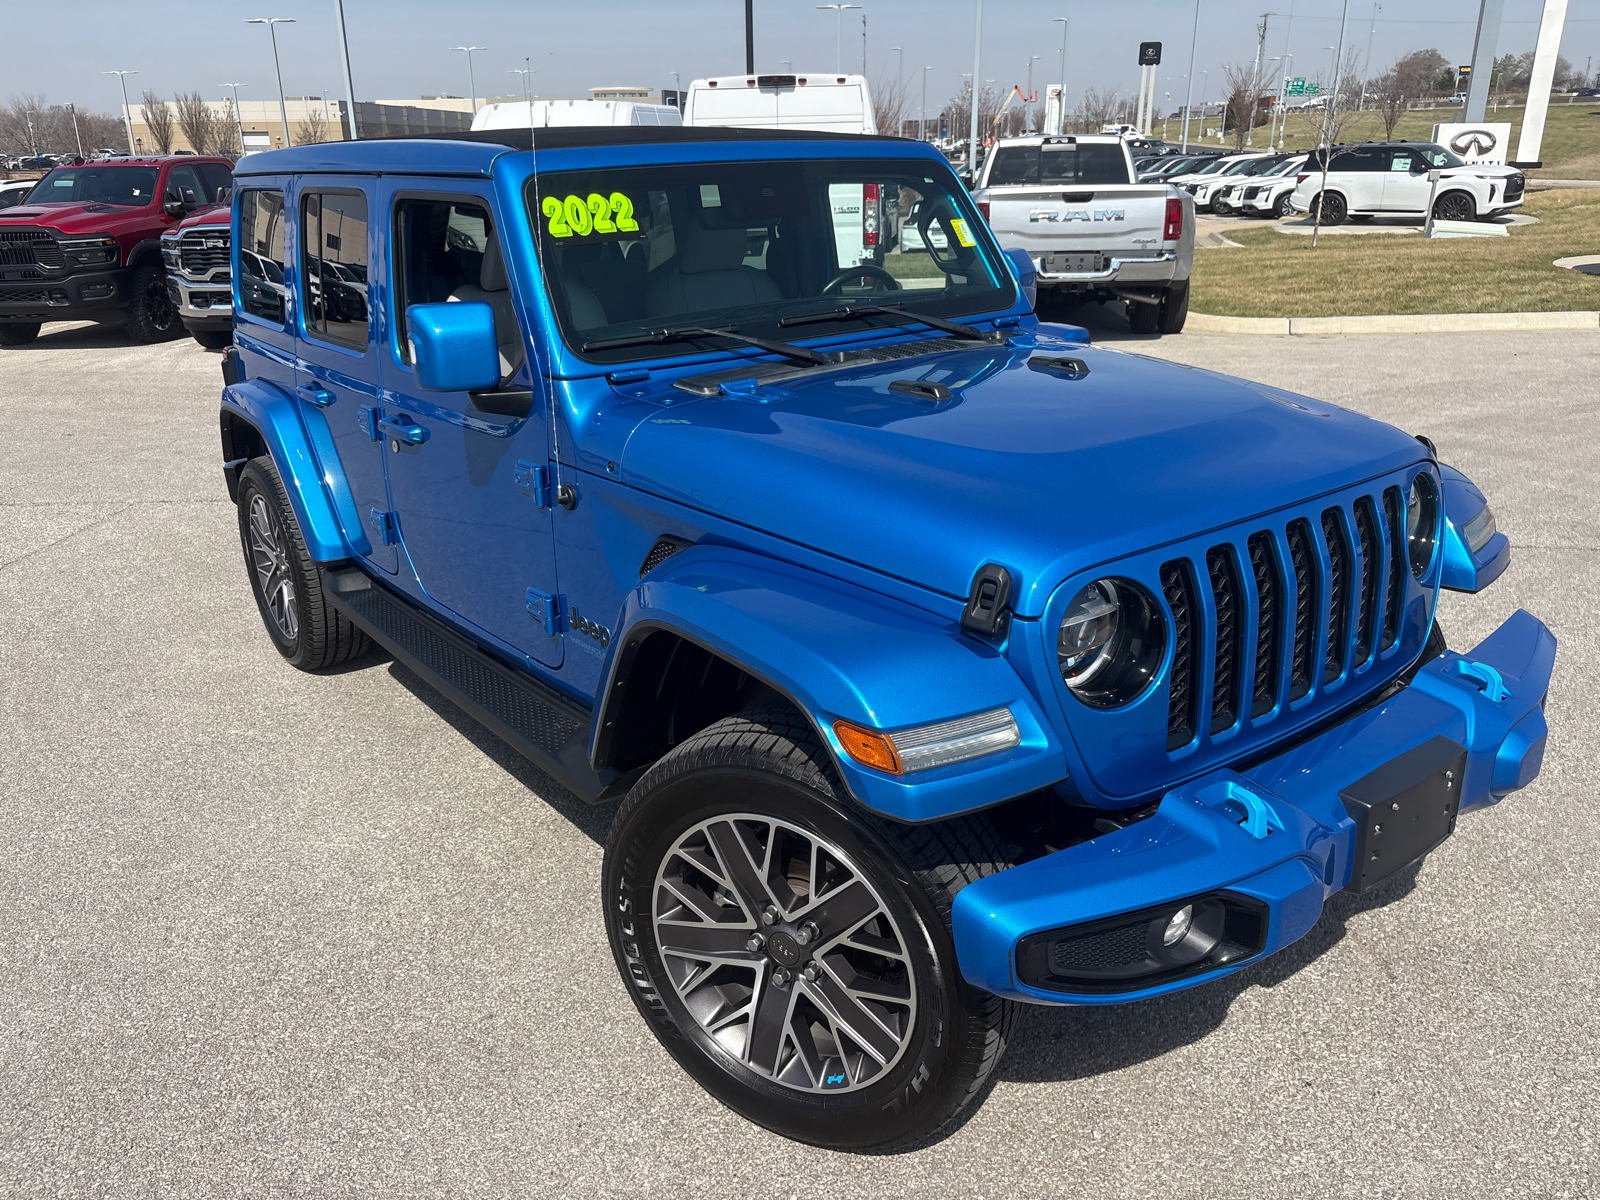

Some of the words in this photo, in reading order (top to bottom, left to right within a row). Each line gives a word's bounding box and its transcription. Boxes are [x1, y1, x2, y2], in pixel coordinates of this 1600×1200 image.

[542, 192, 640, 238] 2022
[1029, 208, 1126, 223] RAM
[566, 605, 610, 649] Jeep
